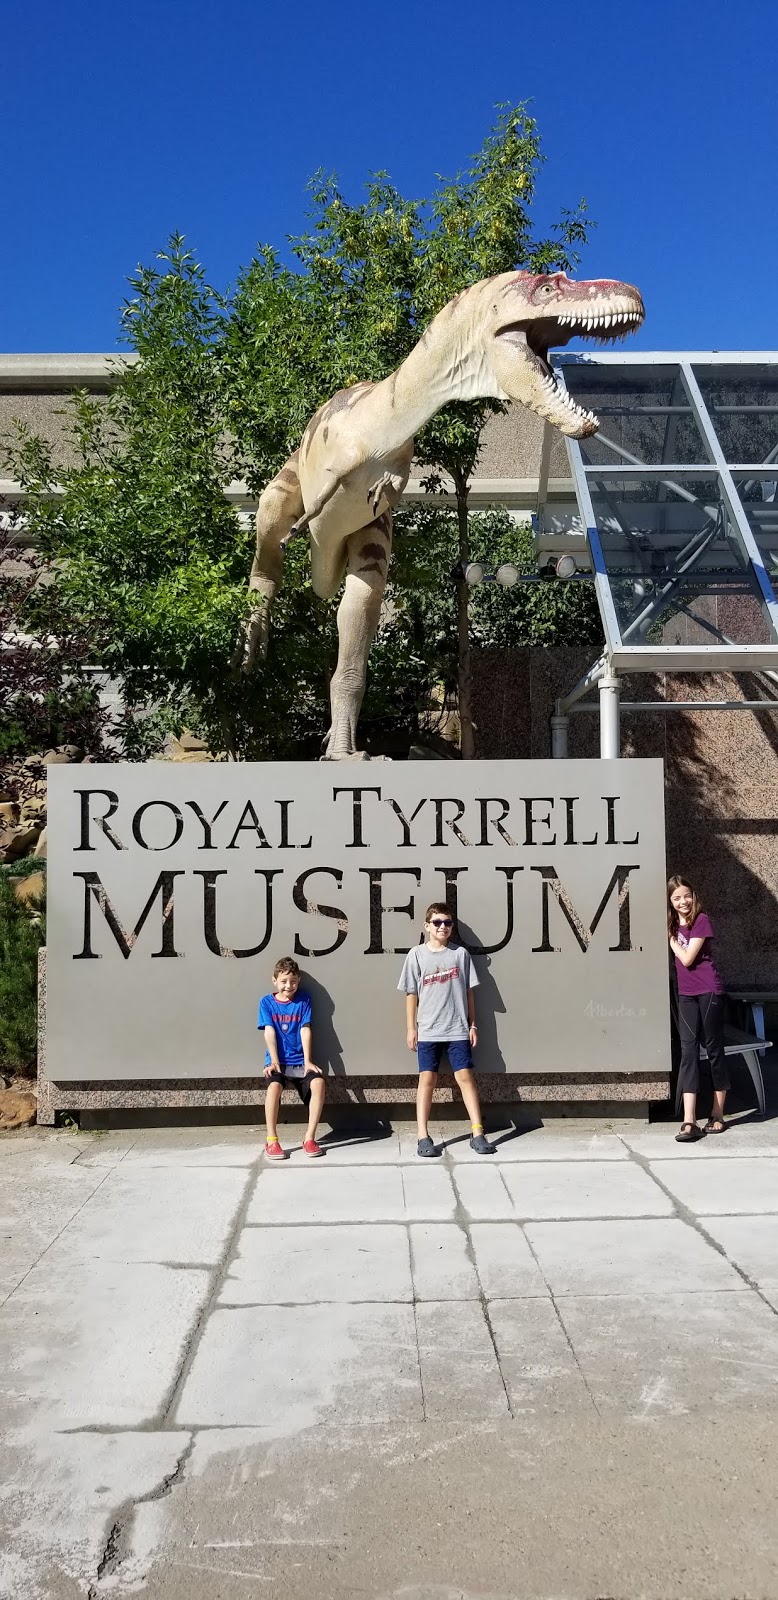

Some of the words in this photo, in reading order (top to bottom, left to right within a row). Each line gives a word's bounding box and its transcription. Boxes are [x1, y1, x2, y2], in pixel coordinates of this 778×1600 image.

[73, 789, 313, 851] ROYAL
[333, 786, 639, 849] TYRRELL
[73, 864, 642, 960] MUSEUM
[584, 999, 636, 1018] Alberta
